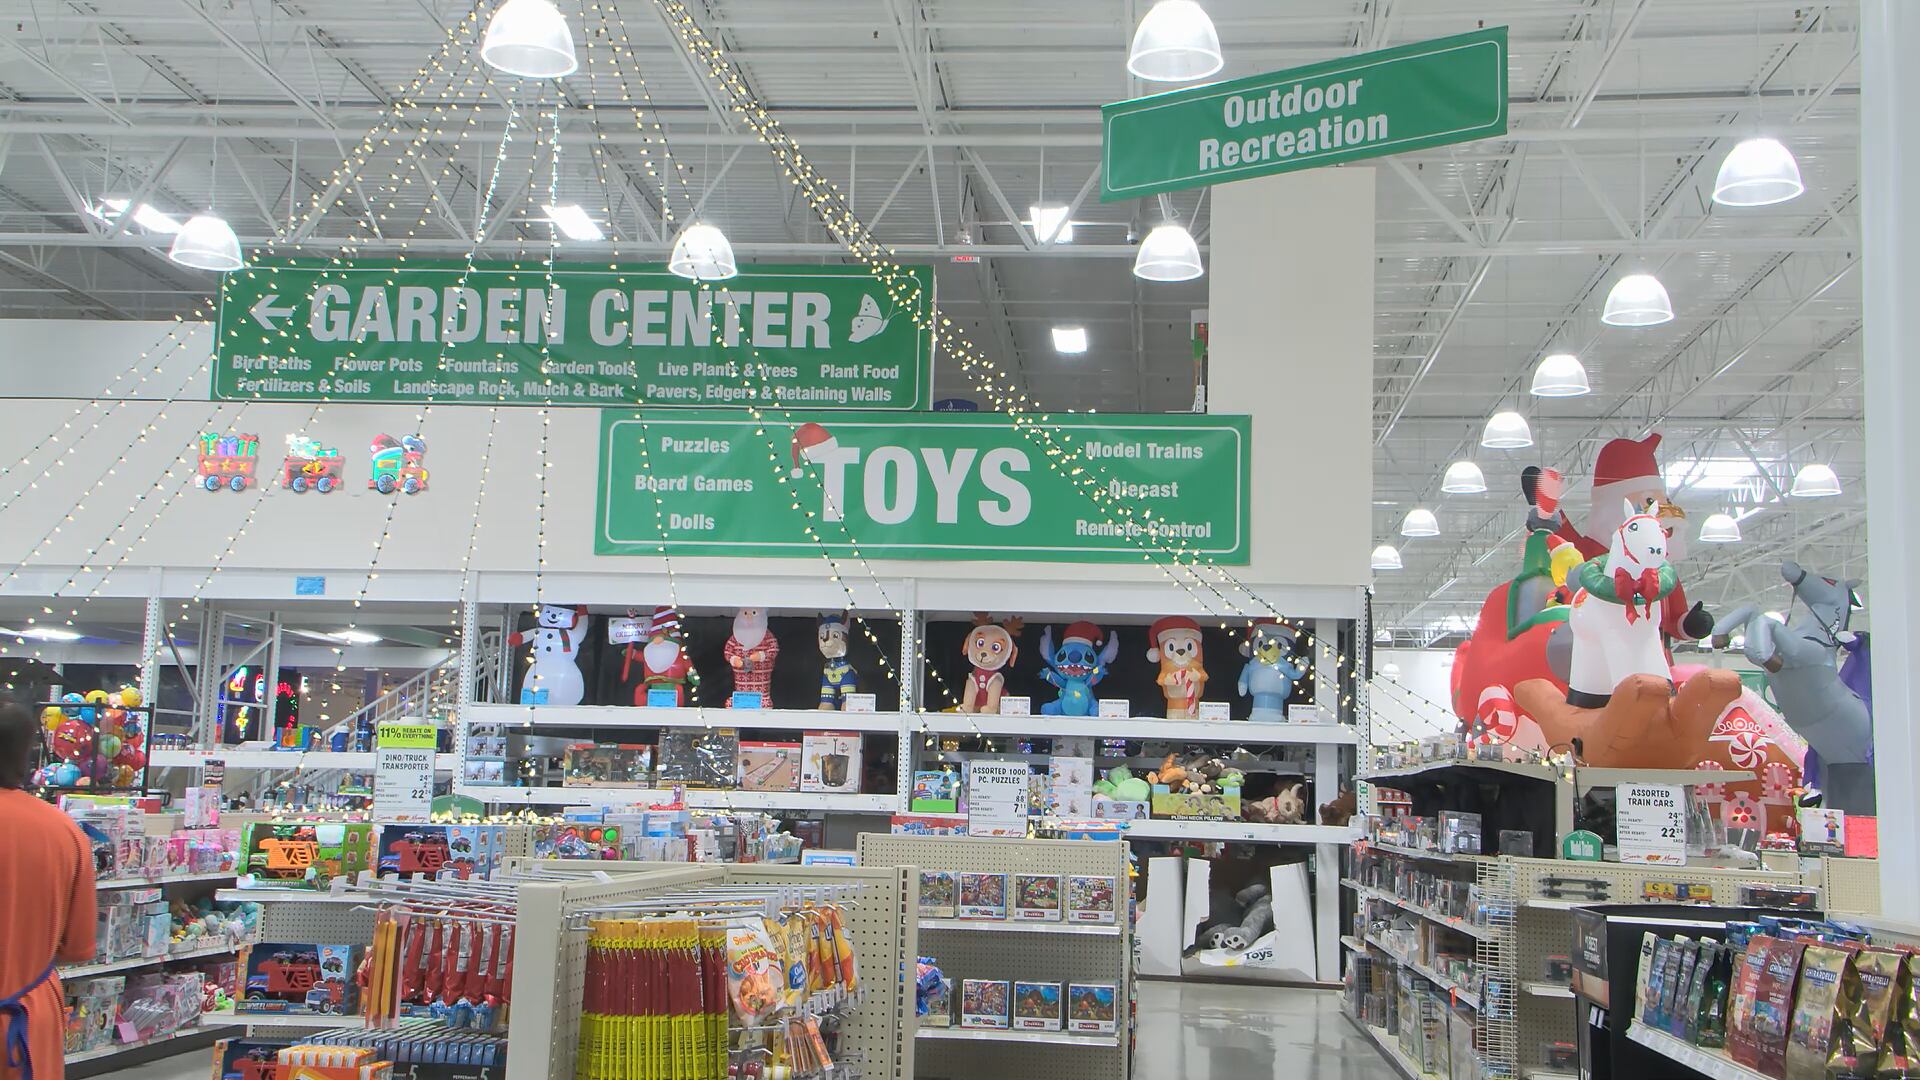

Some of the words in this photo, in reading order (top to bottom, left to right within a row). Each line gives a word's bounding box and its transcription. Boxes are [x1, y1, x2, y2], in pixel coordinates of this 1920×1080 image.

[1223, 78, 1363, 129] Outdoor
[1199, 112, 1388, 170] Recreation
[310, 284, 566, 344] GARDEN
[590, 289, 831, 348] CENTER
[233, 355, 265, 369] Bird
[269, 356, 311, 370] Baths
[334, 357, 385, 371] Flower
[390, 357, 423, 372] Pots
[446, 359, 518, 373] Fountains
[598, 362, 635, 376] Tools
[659, 362, 691, 376] Live
[695, 363, 738, 377] Plants
[744, 365, 755, 377] &
[821, 364, 857, 378] Plant
[862, 365, 899, 379] Food
[238, 378, 314, 393] Fertilizers
[319, 380, 330, 393] &
[335, 380, 371, 394] Soils
[394, 380, 474, 396] Landscape
[478, 381, 520, 397] Rock,
[524, 382, 569, 397] Mulch
[573, 383, 585, 397] &
[589, 384, 624, 398] Bark
[647, 384, 702, 401] Pavers,
[706, 385, 756, 402] Edgers
[761, 387, 773, 400] &
[777, 386, 847, 402] Retaining
[851, 387, 892, 401] Walls
[661, 437, 730, 453] Puzzles
[1085, 441, 1140, 458] Model
[1147, 442, 1203, 459] Trains
[635, 474, 687, 492] Board
[694, 475, 753, 492] Games
[804, 446, 1032, 526] TOYS
[1109, 480, 1179, 498] Diecast
[670, 513, 715, 530] Dolls
[1075, 519, 1141, 537] Remote
[1147, 520, 1211, 538] Control
[379, 727, 401, 739] 11%
[382, 763, 430, 771] TRANSPORTER
[972, 767, 1007, 775] ASSORTED
[1009, 768, 1027, 776] 1000
[991, 776, 1021, 785] PUZZLES
[1631, 788, 1670, 798] ASSORTED
[1627, 798, 1651, 806] TRAIN
[1653, 799, 1674, 808] CARS
[1244, 950, 1273, 960] Toys
